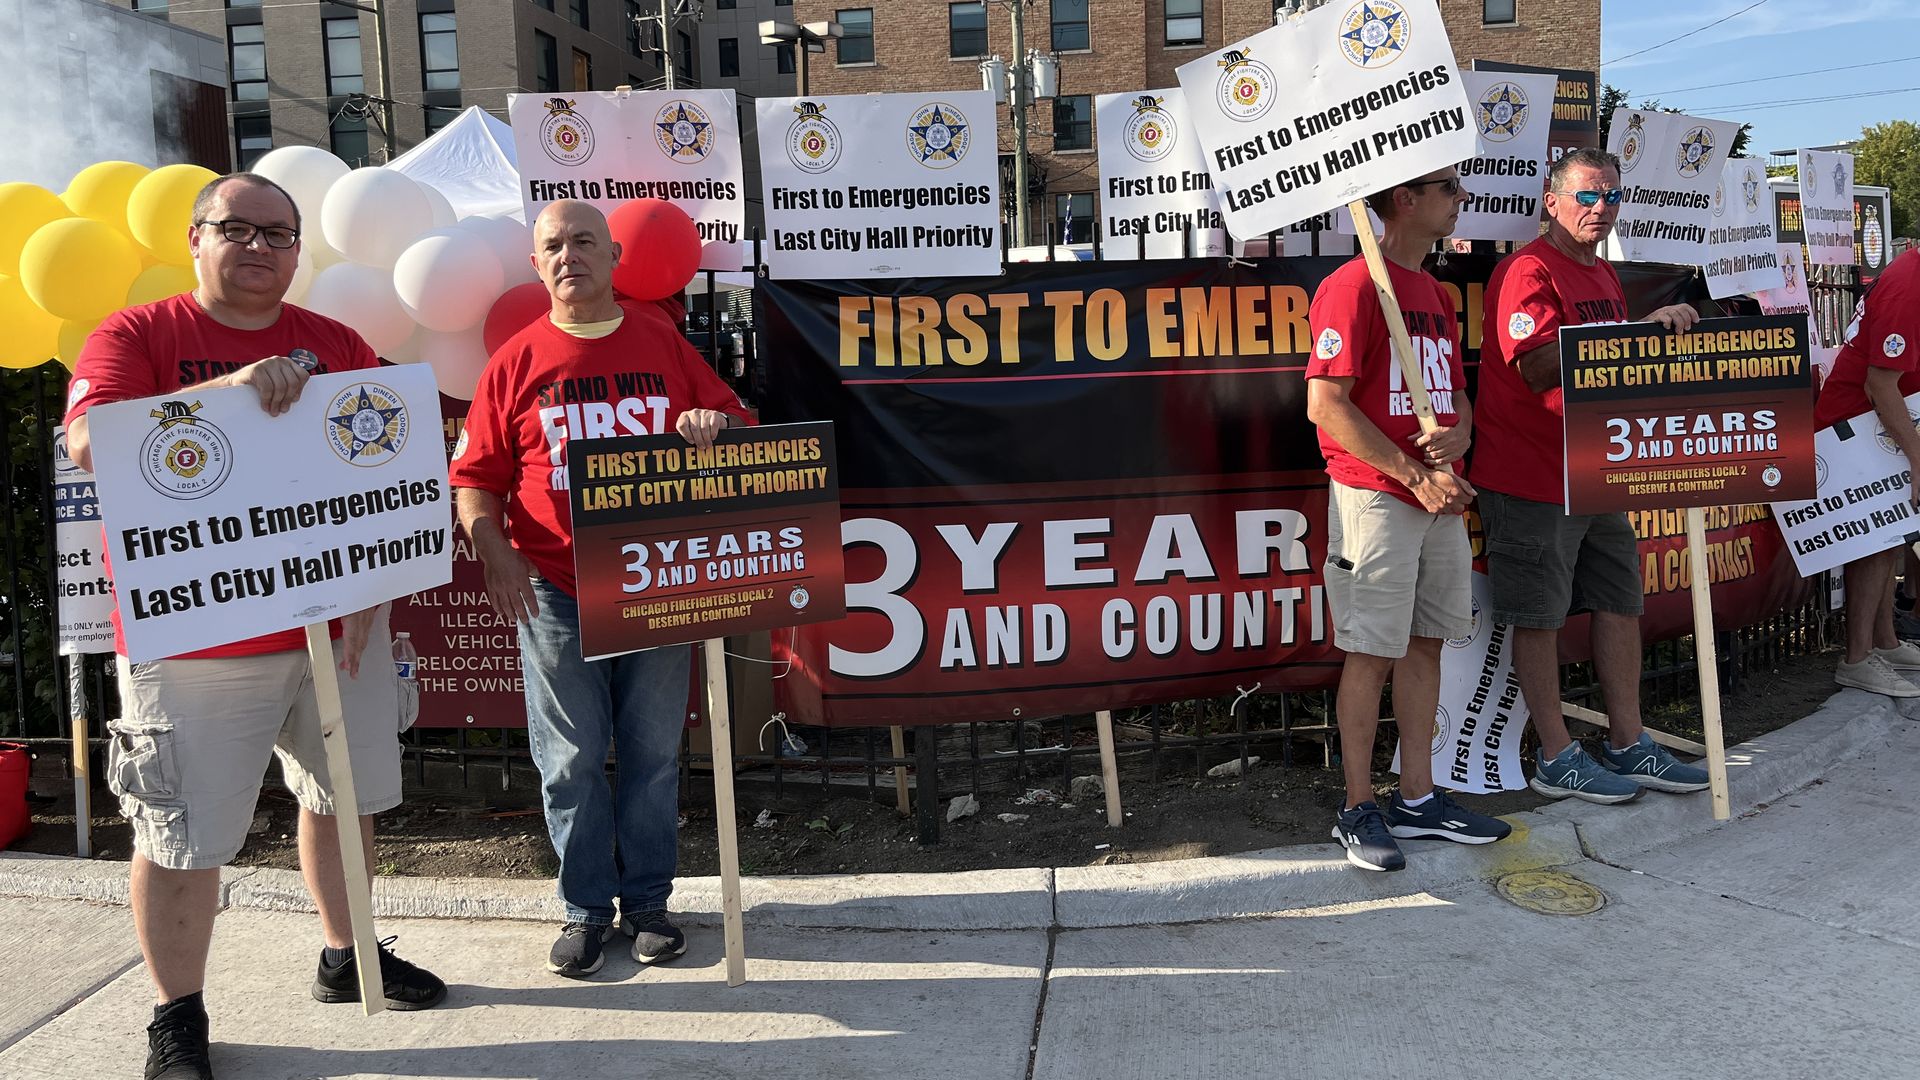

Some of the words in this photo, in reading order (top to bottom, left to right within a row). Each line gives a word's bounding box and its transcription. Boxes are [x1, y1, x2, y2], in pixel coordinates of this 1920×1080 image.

[1345, 10, 1357, 25] JOHN
[1374, 0, 1396, 11] DINEEN
[1399, 15, 1408, 37] LODGE
[1342, 40, 1362, 63] CHICAGO
[916, 107, 929, 120] JOHN
[944, 107, 963, 122] DINEEN
[1214, 135, 1267, 172] First
[1267, 126, 1292, 150] to
[1293, 64, 1450, 141] Emergencies
[1225, 177, 1275, 213] Last
[1275, 161, 1322, 194] City
[1322, 138, 1371, 176] Hall
[1372, 106, 1466, 157] Priority
[530, 180, 577, 201] First
[580, 180, 601, 199] to
[604, 178, 736, 201] Emergencies
[772, 187, 818, 210] First
[822, 188, 843, 209] to
[848, 183, 990, 209] Emergencies
[1109, 176, 1154, 198] First
[1158, 175, 1177, 193] to
[1182, 170, 1214, 191] Em
[1632, 185, 1711, 209] Emergencies
[1462, 192, 1537, 216] Priority
[695, 219, 738, 244] ority
[1109, 215, 1150, 237] Last
[1155, 211, 1192, 233] City
[1197, 208, 1223, 229] Ha
[1631, 219, 1655, 238] Hall
[1654, 220, 1706, 243] Priority
[1719, 229, 1727, 243] to
[1728, 222, 1772, 242] Emergencies
[773, 228, 816, 251] Last
[820, 228, 861, 252] City
[866, 226, 908, 249] Hall
[913, 224, 993, 248] Priority
[1719, 258, 1733, 275] City
[1734, 255, 1747, 273] Hall
[1747, 251, 1778, 271] Priority
[1575, 300, 1615, 321] STAND
[837, 291, 1030, 367] FIRST
[1043, 288, 1129, 362] TO
[1146, 285, 1311, 358] EMER
[1578, 337, 1632, 361] FIRST
[1635, 335, 1661, 357] TO
[1665, 327, 1796, 355] EMERGENCIES
[1677, 354, 1698, 362] BUT
[1574, 366, 1619, 389] LAST
[1623, 363, 1666, 386] CITY
[1669, 361, 1713, 383] HALL
[1716, 355, 1802, 380] PRIORITY
[336, 391, 352, 408] JOHN
[373, 387, 397, 404] DINEEN
[538, 375, 608, 407] STAND
[615, 371, 668, 397] WITH
[152, 443, 162, 473] CHICAGO
[161, 430, 175, 444] FIRE
[177, 428, 211, 442] FIGHTERS
[210, 441, 220, 462] UNION
[329, 425, 349, 456] CHICAGO
[1605, 418, 1633, 462] 3
[1636, 410, 1777, 437] YEARS
[1637, 439, 1674, 459] AND
[1682, 433, 1778, 456] COUNTING
[586, 451, 649, 479] FIRST
[652, 447, 681, 472] TO
[686, 437, 821, 470] EMERGENCIES
[177, 481, 200, 489] LOCAL
[700, 469, 722, 477] BUT
[1605, 469, 1647, 484] CHICAGO
[1648, 466, 1710, 482] FIREFIGHTERS
[1712, 465, 1739, 477] LOCAL
[1740, 464, 1747, 476] 2
[1628, 483, 1668, 495] DESERVE
[1669, 481, 1676, 492] A
[1677, 479, 1726, 492] CONTRACT
[582, 484, 636, 511] LAST
[639, 479, 686, 507] CITY
[691, 475, 739, 501] HALL
[741, 466, 828, 496] PRIORITY
[1782, 500, 1824, 528] First
[1823, 494, 1844, 515] to
[1843, 470, 1911, 505] Emerge
[122, 519, 204, 562] First
[207, 516, 243, 546] to
[248, 478, 441, 538] Emergencies
[1793, 526, 1834, 556] Last
[1832, 516, 1870, 541] City
[1869, 502, 1909, 528] Hall
[130, 578, 206, 621] Last
[210, 566, 276, 603] City
[281, 548, 344, 589] Hall
[347, 528, 446, 574] Priority
[620, 542, 654, 594] 3
[655, 526, 804, 563] YEARS
[657, 563, 697, 589] AND
[706, 550, 805, 582] COUNTING
[1664, 536, 1755, 591] COTRACT
[409, 591, 442, 606] ALL
[449, 591, 491, 606] UNA
[622, 602, 667, 620] CHICAGO
[669, 594, 737, 615] FIREFIGHTERS
[738, 590, 765, 606] LOCAL
[766, 588, 774, 600] 2
[827, 517, 925, 677] 3
[935, 508, 1312, 591] YEAR
[74, 622, 93, 630] ONLY
[95, 620, 114, 629] with
[440, 613, 517, 628] ILLEGAL
[648, 612, 690, 630] DESERVE
[692, 611, 700, 624] A
[701, 605, 752, 624] CONTRACT
[939, 603, 1068, 669] AND
[1100, 584, 1325, 658] COUNTI
[78, 632, 115, 642] employer
[1466, 621, 1507, 716] Emergenc
[421, 678, 458, 692] THE
[464, 678, 524, 692] OWNE
[1499, 669, 1521, 711] Hall
[1460, 717, 1477, 737] to
[1485, 710, 1509, 751] City
[1451, 740, 1471, 784] First
[1483, 753, 1504, 792] Last
